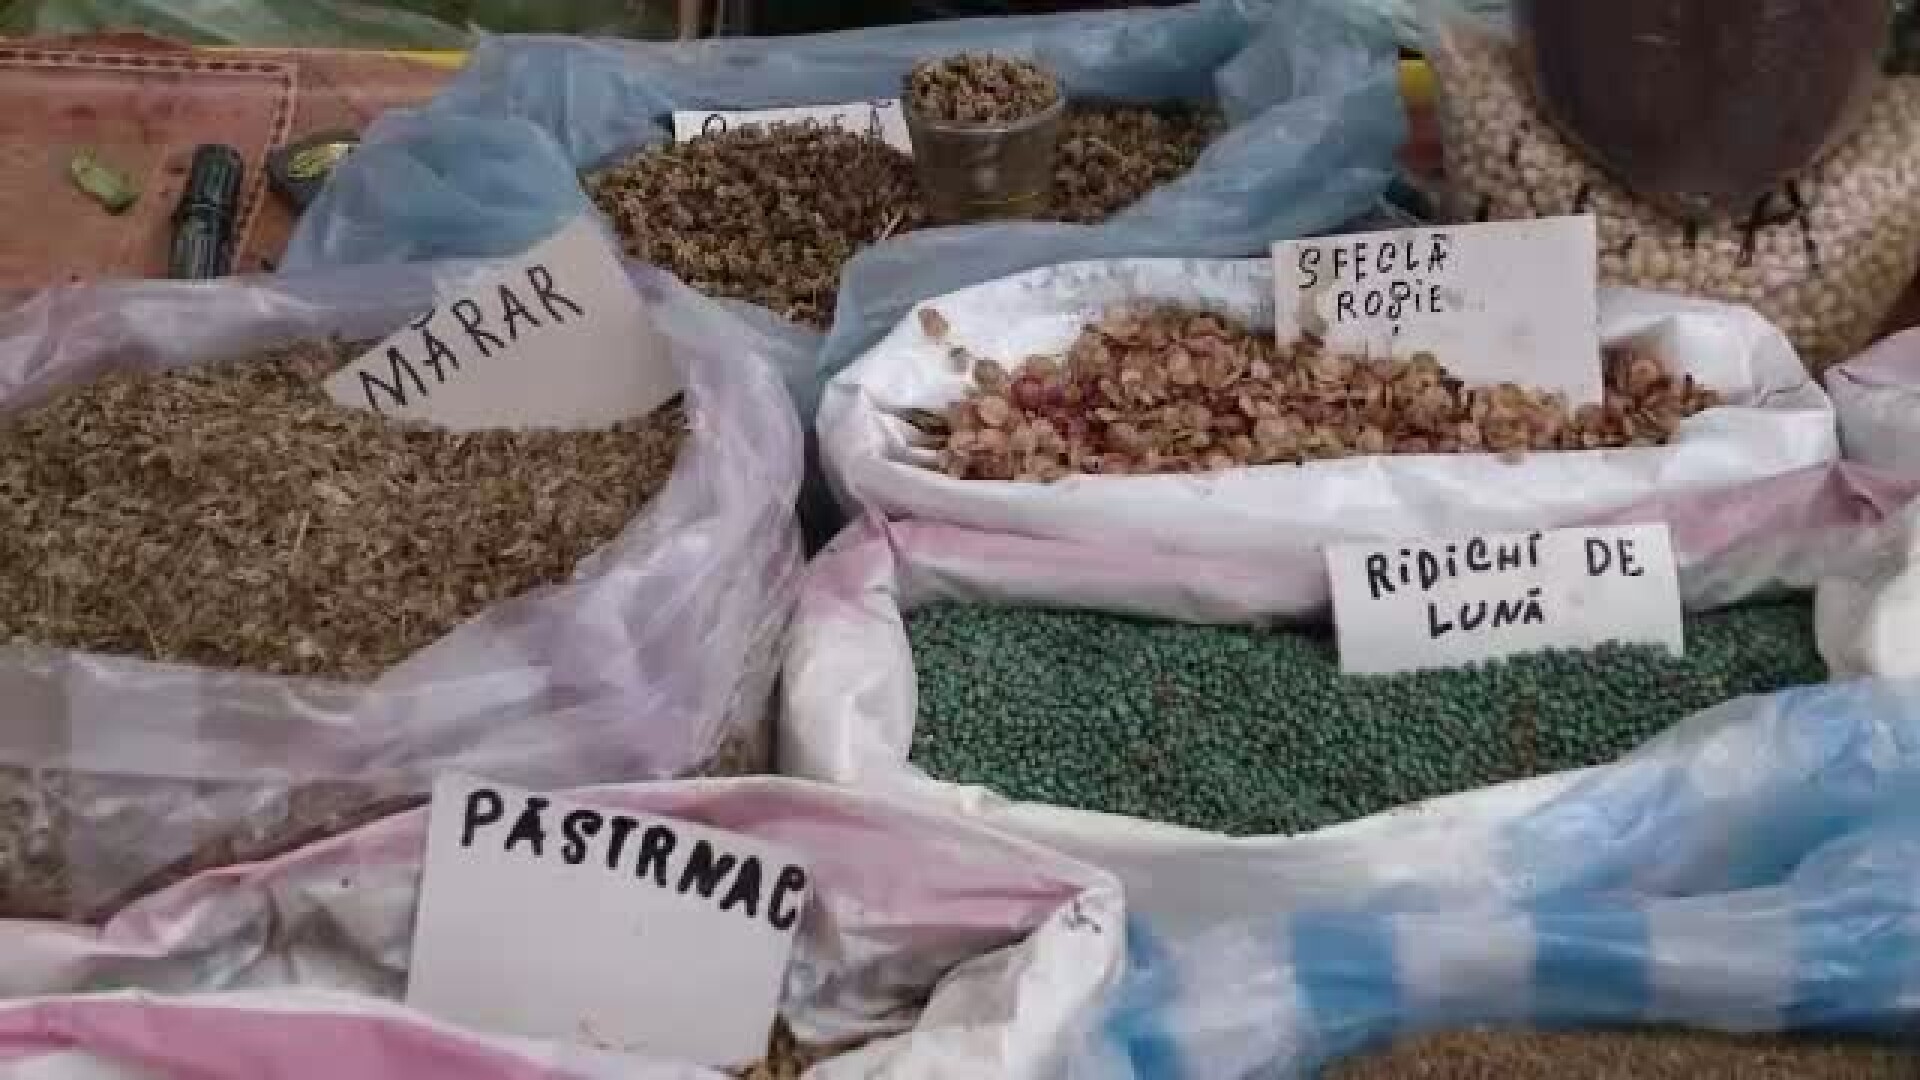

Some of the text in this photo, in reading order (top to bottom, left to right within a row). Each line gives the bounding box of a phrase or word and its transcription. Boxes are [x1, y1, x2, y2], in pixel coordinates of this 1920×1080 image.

[359, 264, 585, 410] MĂRAR
[1584, 537, 1644, 576] DE
[1427, 587, 1543, 638] LUNĂ
[460, 789, 805, 930] PĂSTRNAC
